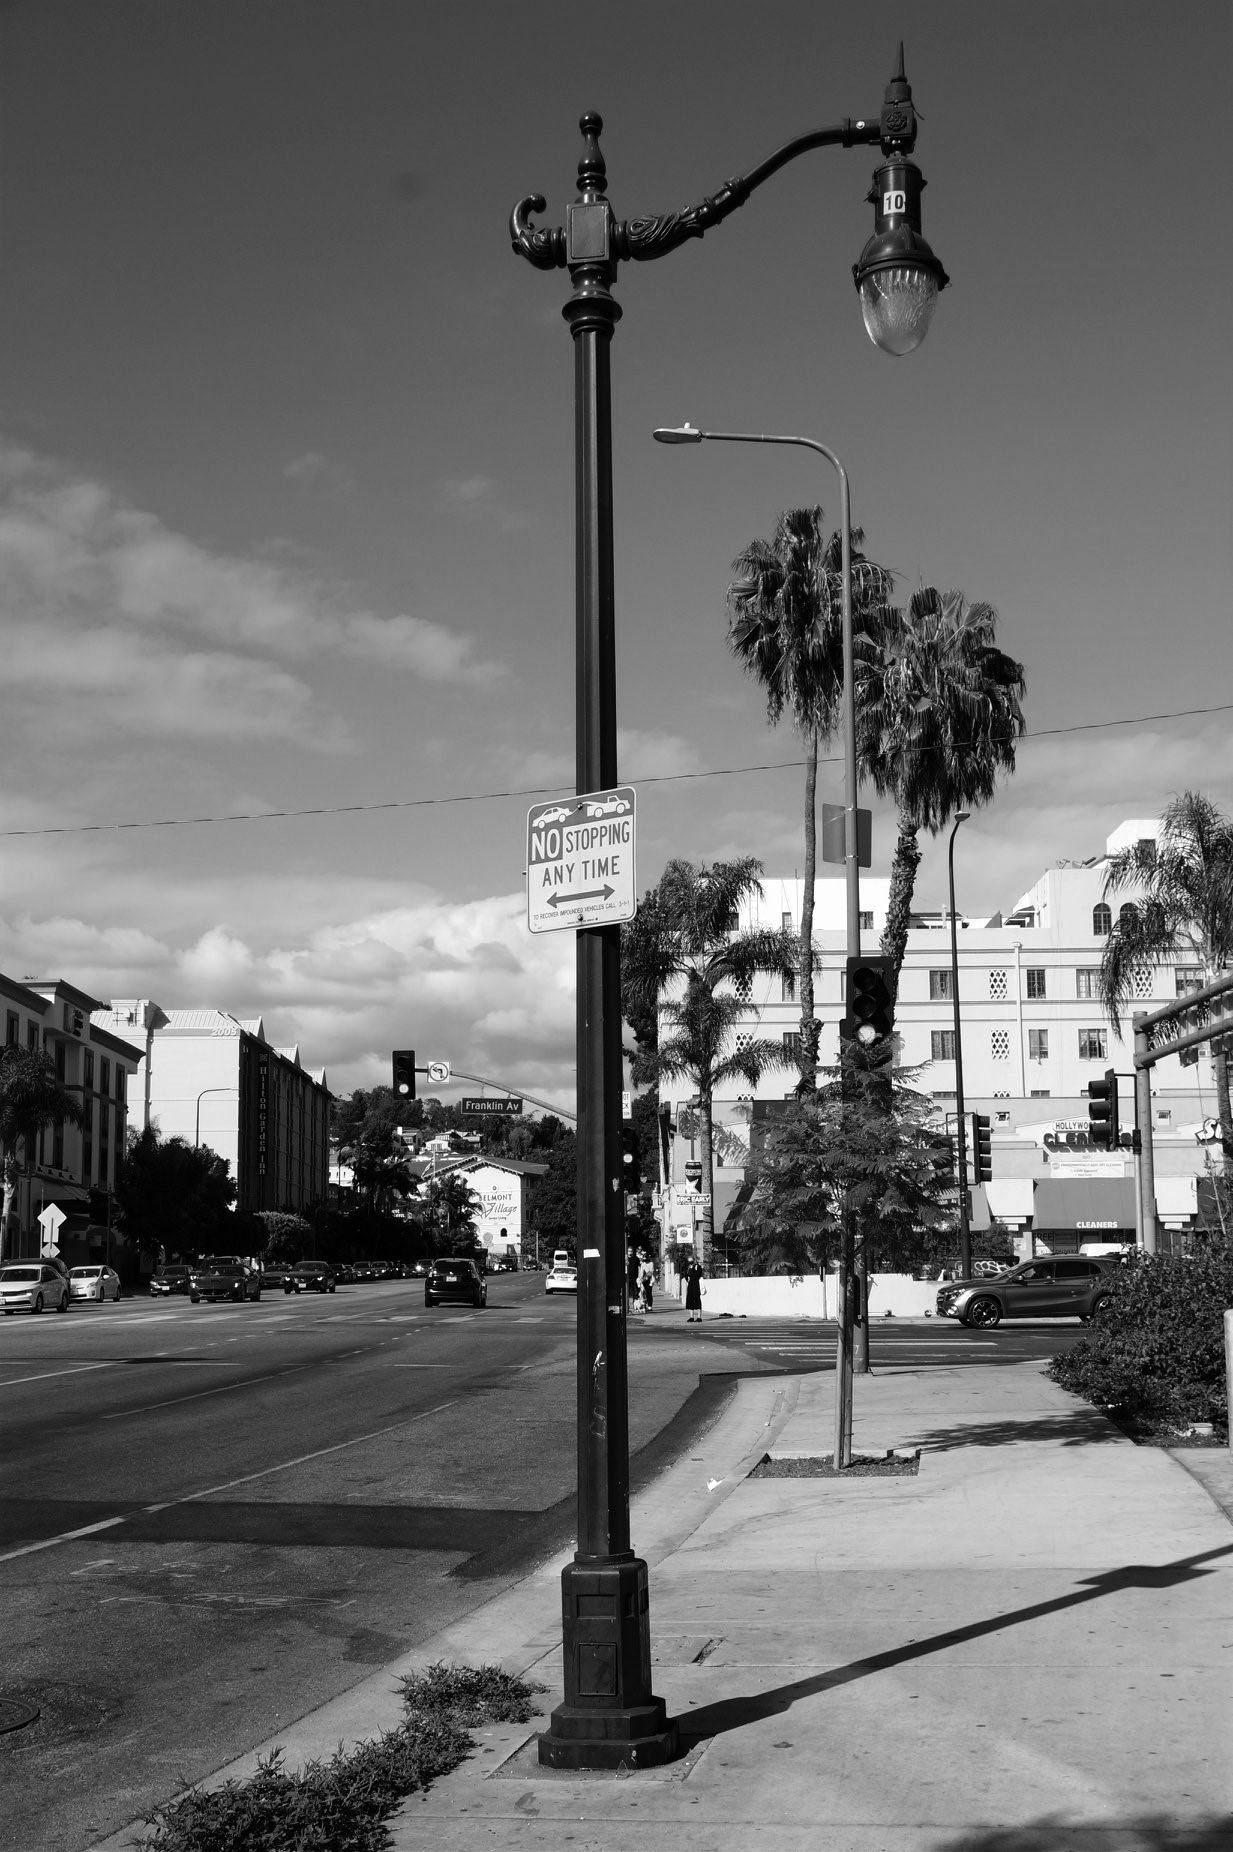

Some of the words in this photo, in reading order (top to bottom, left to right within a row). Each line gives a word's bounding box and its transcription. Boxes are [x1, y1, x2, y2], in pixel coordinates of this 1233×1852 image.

[885, 194, 904, 211] 10
[531, 828, 561, 862] NO
[565, 820, 630, 853] STOPPING
[542, 862, 576, 887] ANY
[581, 855, 620, 881] TIME
[560, 907, 584, 917] IMPOUNDED
[584, 903, 605, 912] VEHICLES
[465, 1100, 503, 1111] Franklin
[506, 1101, 519, 1111] Av
[1043, 1132, 1132, 1146] CLEAS
[478, 1194, 512, 1202] BELMONT
[485, 1203, 518, 1218] Village
[1076, 1221, 1118, 1229] CLEANERS
